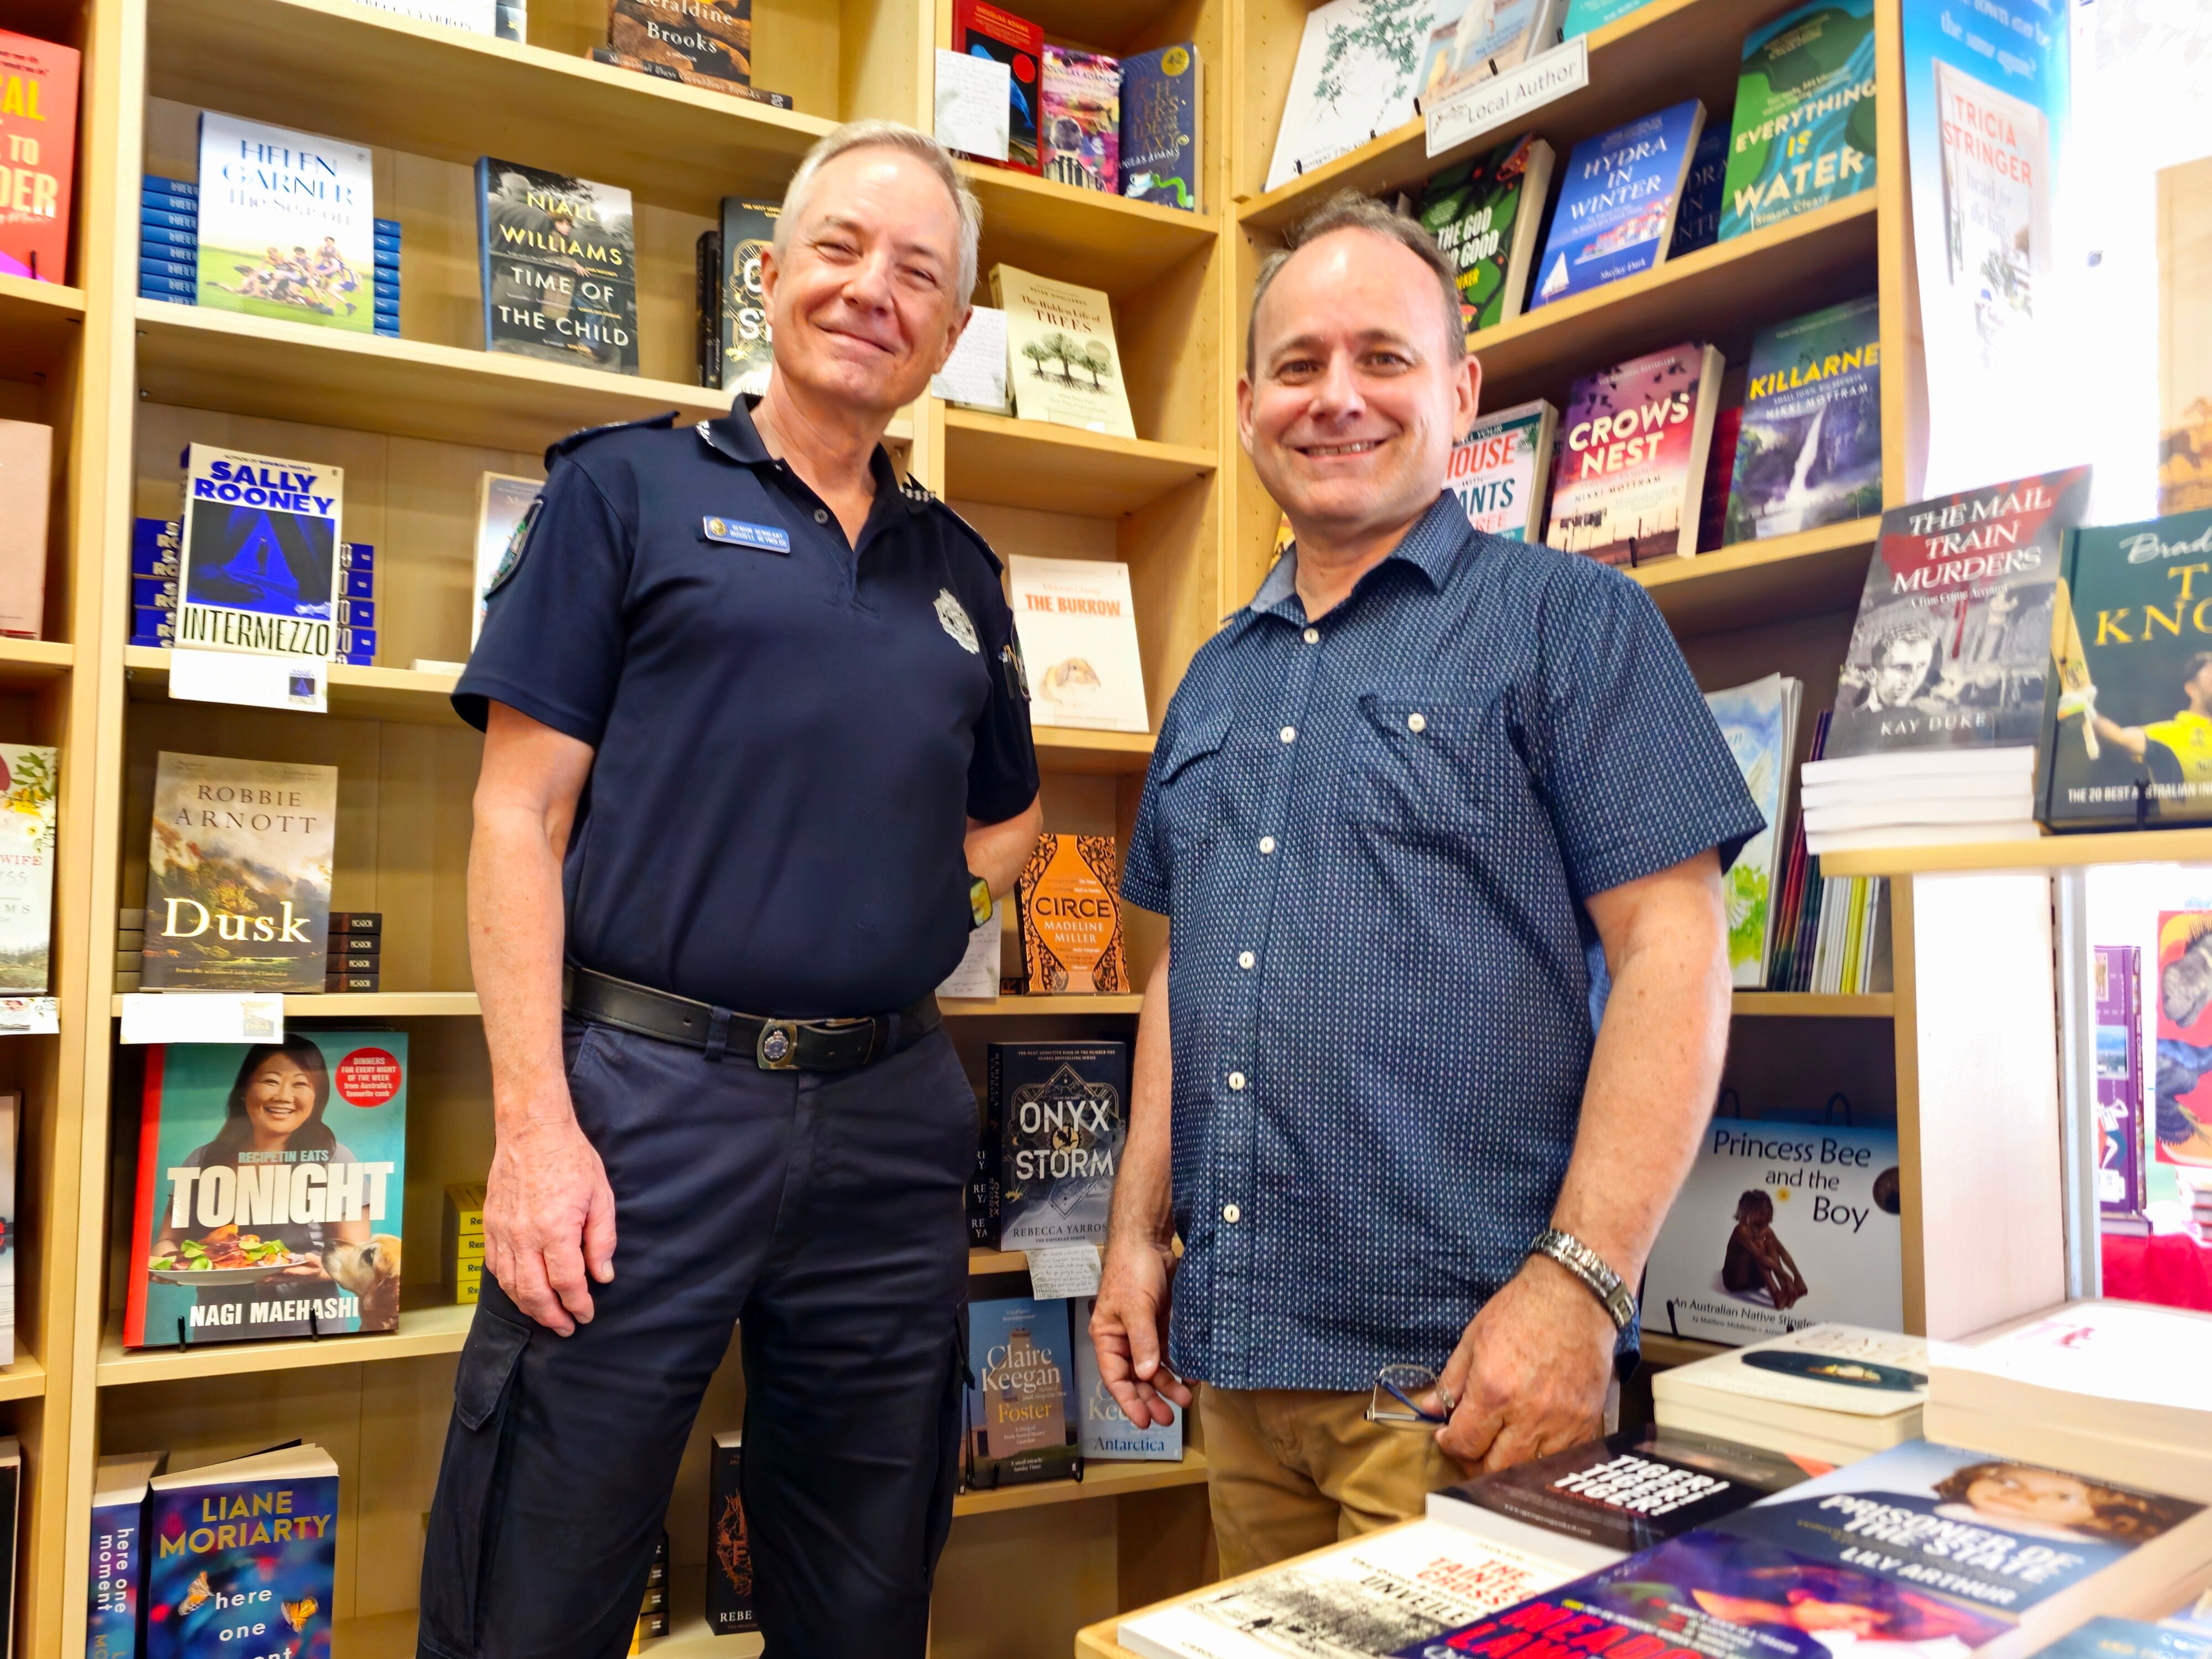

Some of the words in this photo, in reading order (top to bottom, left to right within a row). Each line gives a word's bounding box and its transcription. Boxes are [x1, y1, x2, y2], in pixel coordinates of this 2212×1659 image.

[636, 0, 733, 25] eraldine
[647, 20, 718, 54] Brooks
[0, 75, 45, 122] AL
[1467, 87, 1510, 124] Local
[1515, 61, 1576, 103] Author
[1736, 78, 1876, 153] EVERYTHING
[1954, 95, 2017, 148] TRICIA
[7, 134, 39, 166] TO
[241, 140, 337, 178] HELEN
[1584, 136, 1667, 179] HYDRA
[1787, 130, 1812, 158] IS
[1942, 121, 2032, 187] STRINGER
[222, 163, 353, 206] GARNER
[1608, 165, 1633, 188] IN
[1734, 146, 1864, 219] WATER
[527, 191, 595, 222] NIALL
[1571, 174, 1661, 220] WINTER
[500, 224, 623, 266] WILLIAMS
[1438, 220, 1463, 250] THE
[1463, 206, 1492, 241] GOD
[1460, 229, 1499, 268] GOOD
[511, 266, 572, 295] TIME
[581, 282, 614, 303] OF
[498, 305, 546, 330] THE
[556, 317, 629, 346] CHILD
[1021, 294, 1038, 307] The
[1039, 299, 1071, 316] Hidden
[1073, 308, 1090, 320] Life
[1091, 313, 1101, 324] of
[1033, 307, 1092, 334] TREES
[1749, 342, 1880, 401] KILLARNE
[1766, 402, 1801, 419] NIKKI
[1806, 382, 1868, 408] MOTTRAM
[1569, 393, 1690, 452] CROWS
[1581, 431, 1664, 479] NEST
[210, 461, 317, 494] SALLY
[195, 478, 335, 515] ROONEY
[1458, 478, 1515, 515] ANTS
[1575, 490, 1604, 503] NIKKI
[1910, 502, 1966, 537] THE
[1970, 486, 2052, 523] MAIL
[1475, 512, 1507, 532] REE
[1925, 520, 2020, 560] TRAIN
[2118, 526, 2212, 564] Brad
[1892, 546, 2041, 594] MURDERS
[1025, 594, 1053, 612] THE
[1058, 598, 1121, 617] BURROW
[183, 607, 329, 656] INTERMEZZO
[1881, 718, 1921, 737] KAY
[1929, 712, 1986, 732] DUKE
[197, 785, 301, 807] ROBBIE
[2068, 787, 2087, 803] THE
[2104, 785, 2131, 802] BEST
[174, 808, 316, 833] ARNOTT
[160, 897, 312, 943] Dusk
[352, 920, 372, 928] PICADOR
[1035, 896, 1111, 919] CIRCE
[1045, 921, 1104, 931] MADELINE
[1055, 933, 1096, 943] MILLER
[349, 979, 371, 988] PICADOR
[1019, 1100, 1110, 1134] ONYX
[239, 1151, 297, 1164] RECIPETIN
[300, 1150, 329, 1163] EATS
[1016, 1149, 1114, 1180] STORM
[1714, 1129, 1814, 1163] Princess
[1820, 1138, 1871, 1168] Bee
[167, 1162, 395, 1228] TONIGHT
[1765, 1168, 1801, 1187] and
[1808, 1171, 1840, 1191] the
[1014, 1226, 1063, 1237] REBECCA
[1067, 1223, 1106, 1234] YARROS
[1813, 1196, 1869, 1233] Boy
[189, 1303, 242, 1328] NAGI
[250, 1296, 359, 1324] MAEHASHI
[1673, 1297, 1687, 1309] An
[1690, 1299, 1738, 1317] Australian
[1742, 1308, 1775, 1323] Native
[987, 1344, 1051, 1370] Claire
[982, 1367, 1060, 1393] Keegan
[998, 1404, 1051, 1423] Foster
[1095, 1436, 1164, 1451] Antarctica
[1582, 1463, 1704, 1505] TIGER!
[1608, 1454, 1729, 1495] TIGER!
[202, 1491, 293, 1523] LIANE
[1554, 1473, 1679, 1516] TIGER!
[116, 1528, 134, 1571] here
[160, 1514, 331, 1559] MORIARTY
[1819, 1494, 2017, 1549] PRISONER
[2018, 1544, 2085, 1572] OF
[1845, 1516, 1926, 1547] THE
[1923, 1537, 2062, 1584] STATE
[97, 1534, 113, 1612] moment
[1417, 1570, 1507, 1605] CROSS
[1480, 1559, 1532, 1580] THE
[1840, 1547, 1903, 1571] LILY
[1898, 1563, 2017, 1605] ARTHUR
[115, 1578, 128, 1614] one
[215, 1589, 273, 1610] here
[1361, 1575, 1469, 1622] UNVEILE
[220, 1622, 266, 1641] one
[720, 1610, 753, 1623] REBE
